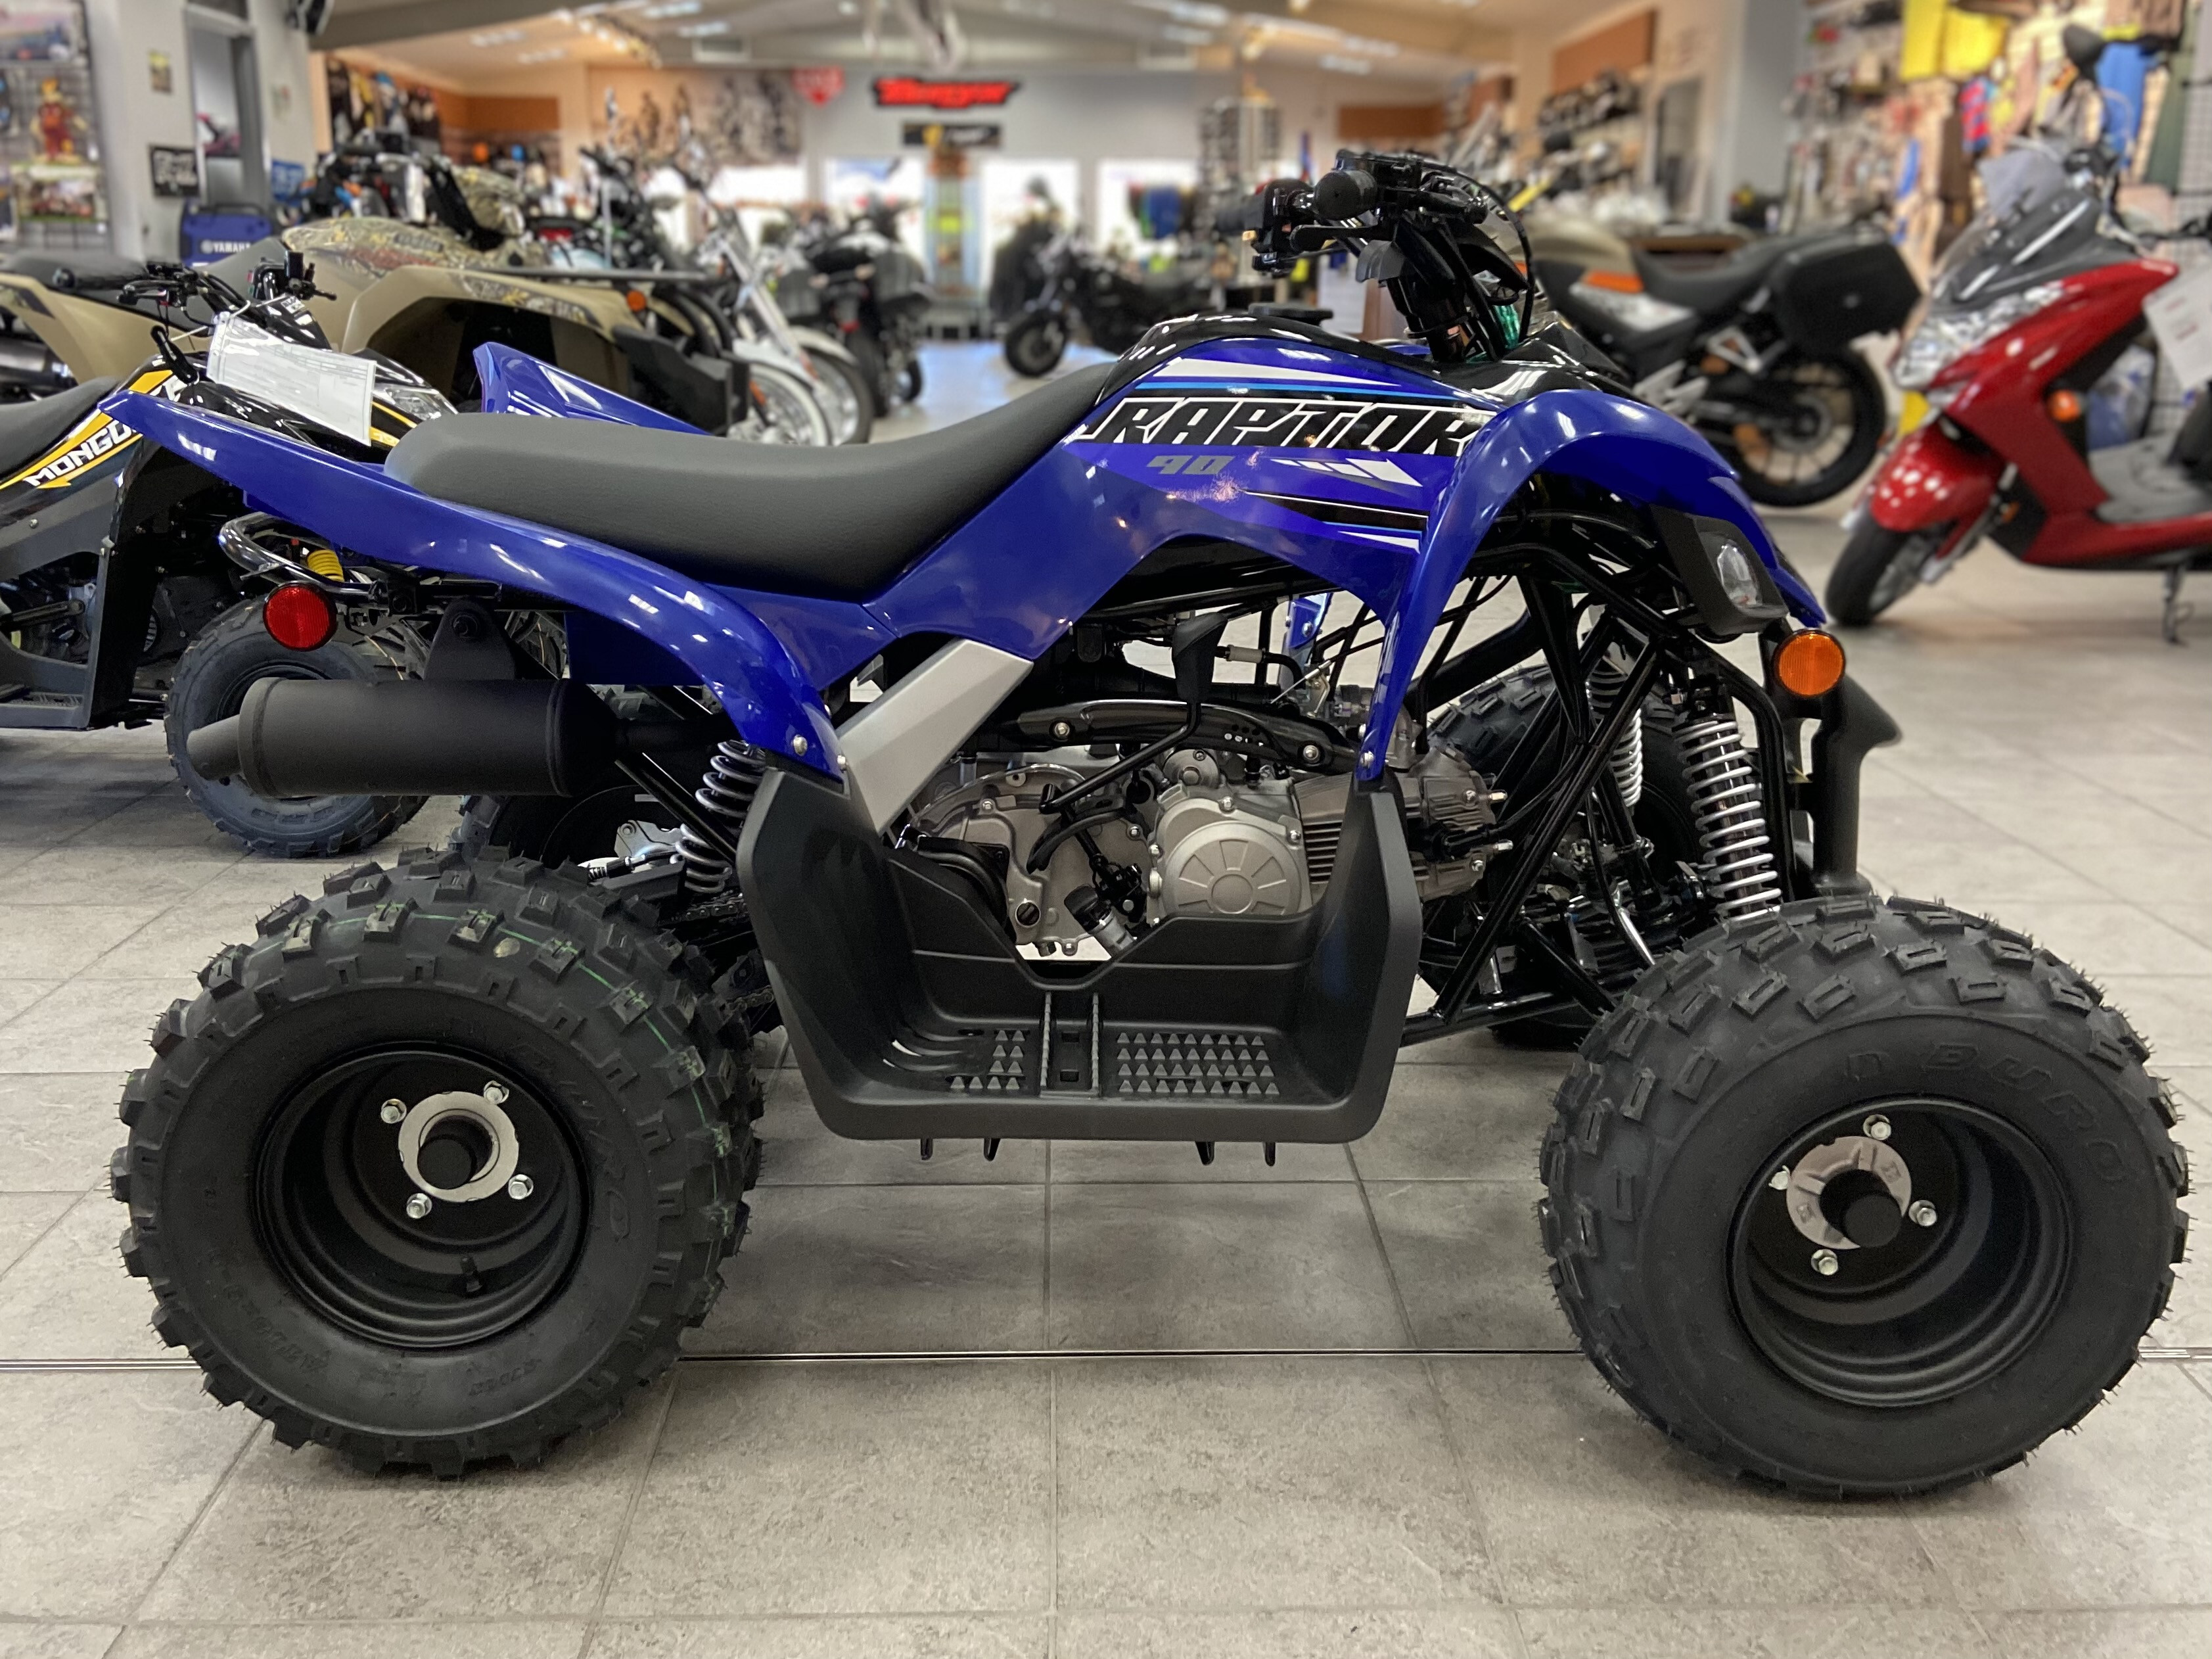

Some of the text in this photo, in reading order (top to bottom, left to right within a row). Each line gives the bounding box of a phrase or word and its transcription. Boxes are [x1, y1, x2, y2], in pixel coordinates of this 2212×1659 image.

[1078, 397, 1497, 457] RAPTOR
[1146, 456, 1236, 475] 90
[1923, 1042, 2129, 1185] DURO
